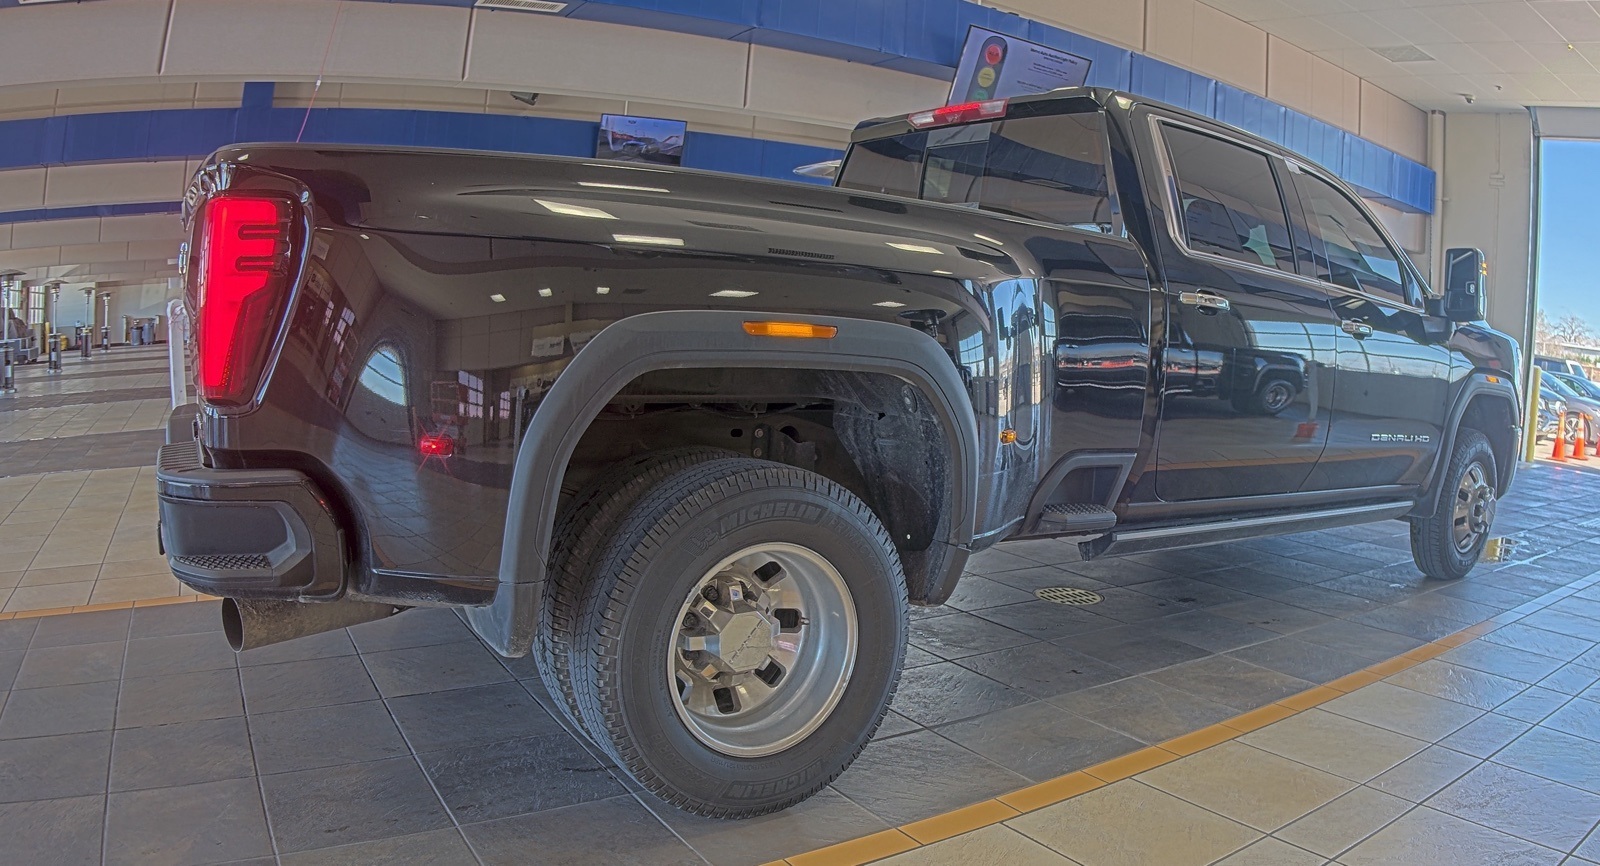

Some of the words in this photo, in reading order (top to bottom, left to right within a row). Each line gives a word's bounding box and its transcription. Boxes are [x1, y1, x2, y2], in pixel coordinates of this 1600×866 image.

[1371, 433, 1413, 442] DENALI
[1414, 434, 1430, 443] HD
[719, 502, 822, 534] MICHELIN
[827, 517, 875, 560] PRIMACY
[727, 761, 823, 799] MICHELIN
